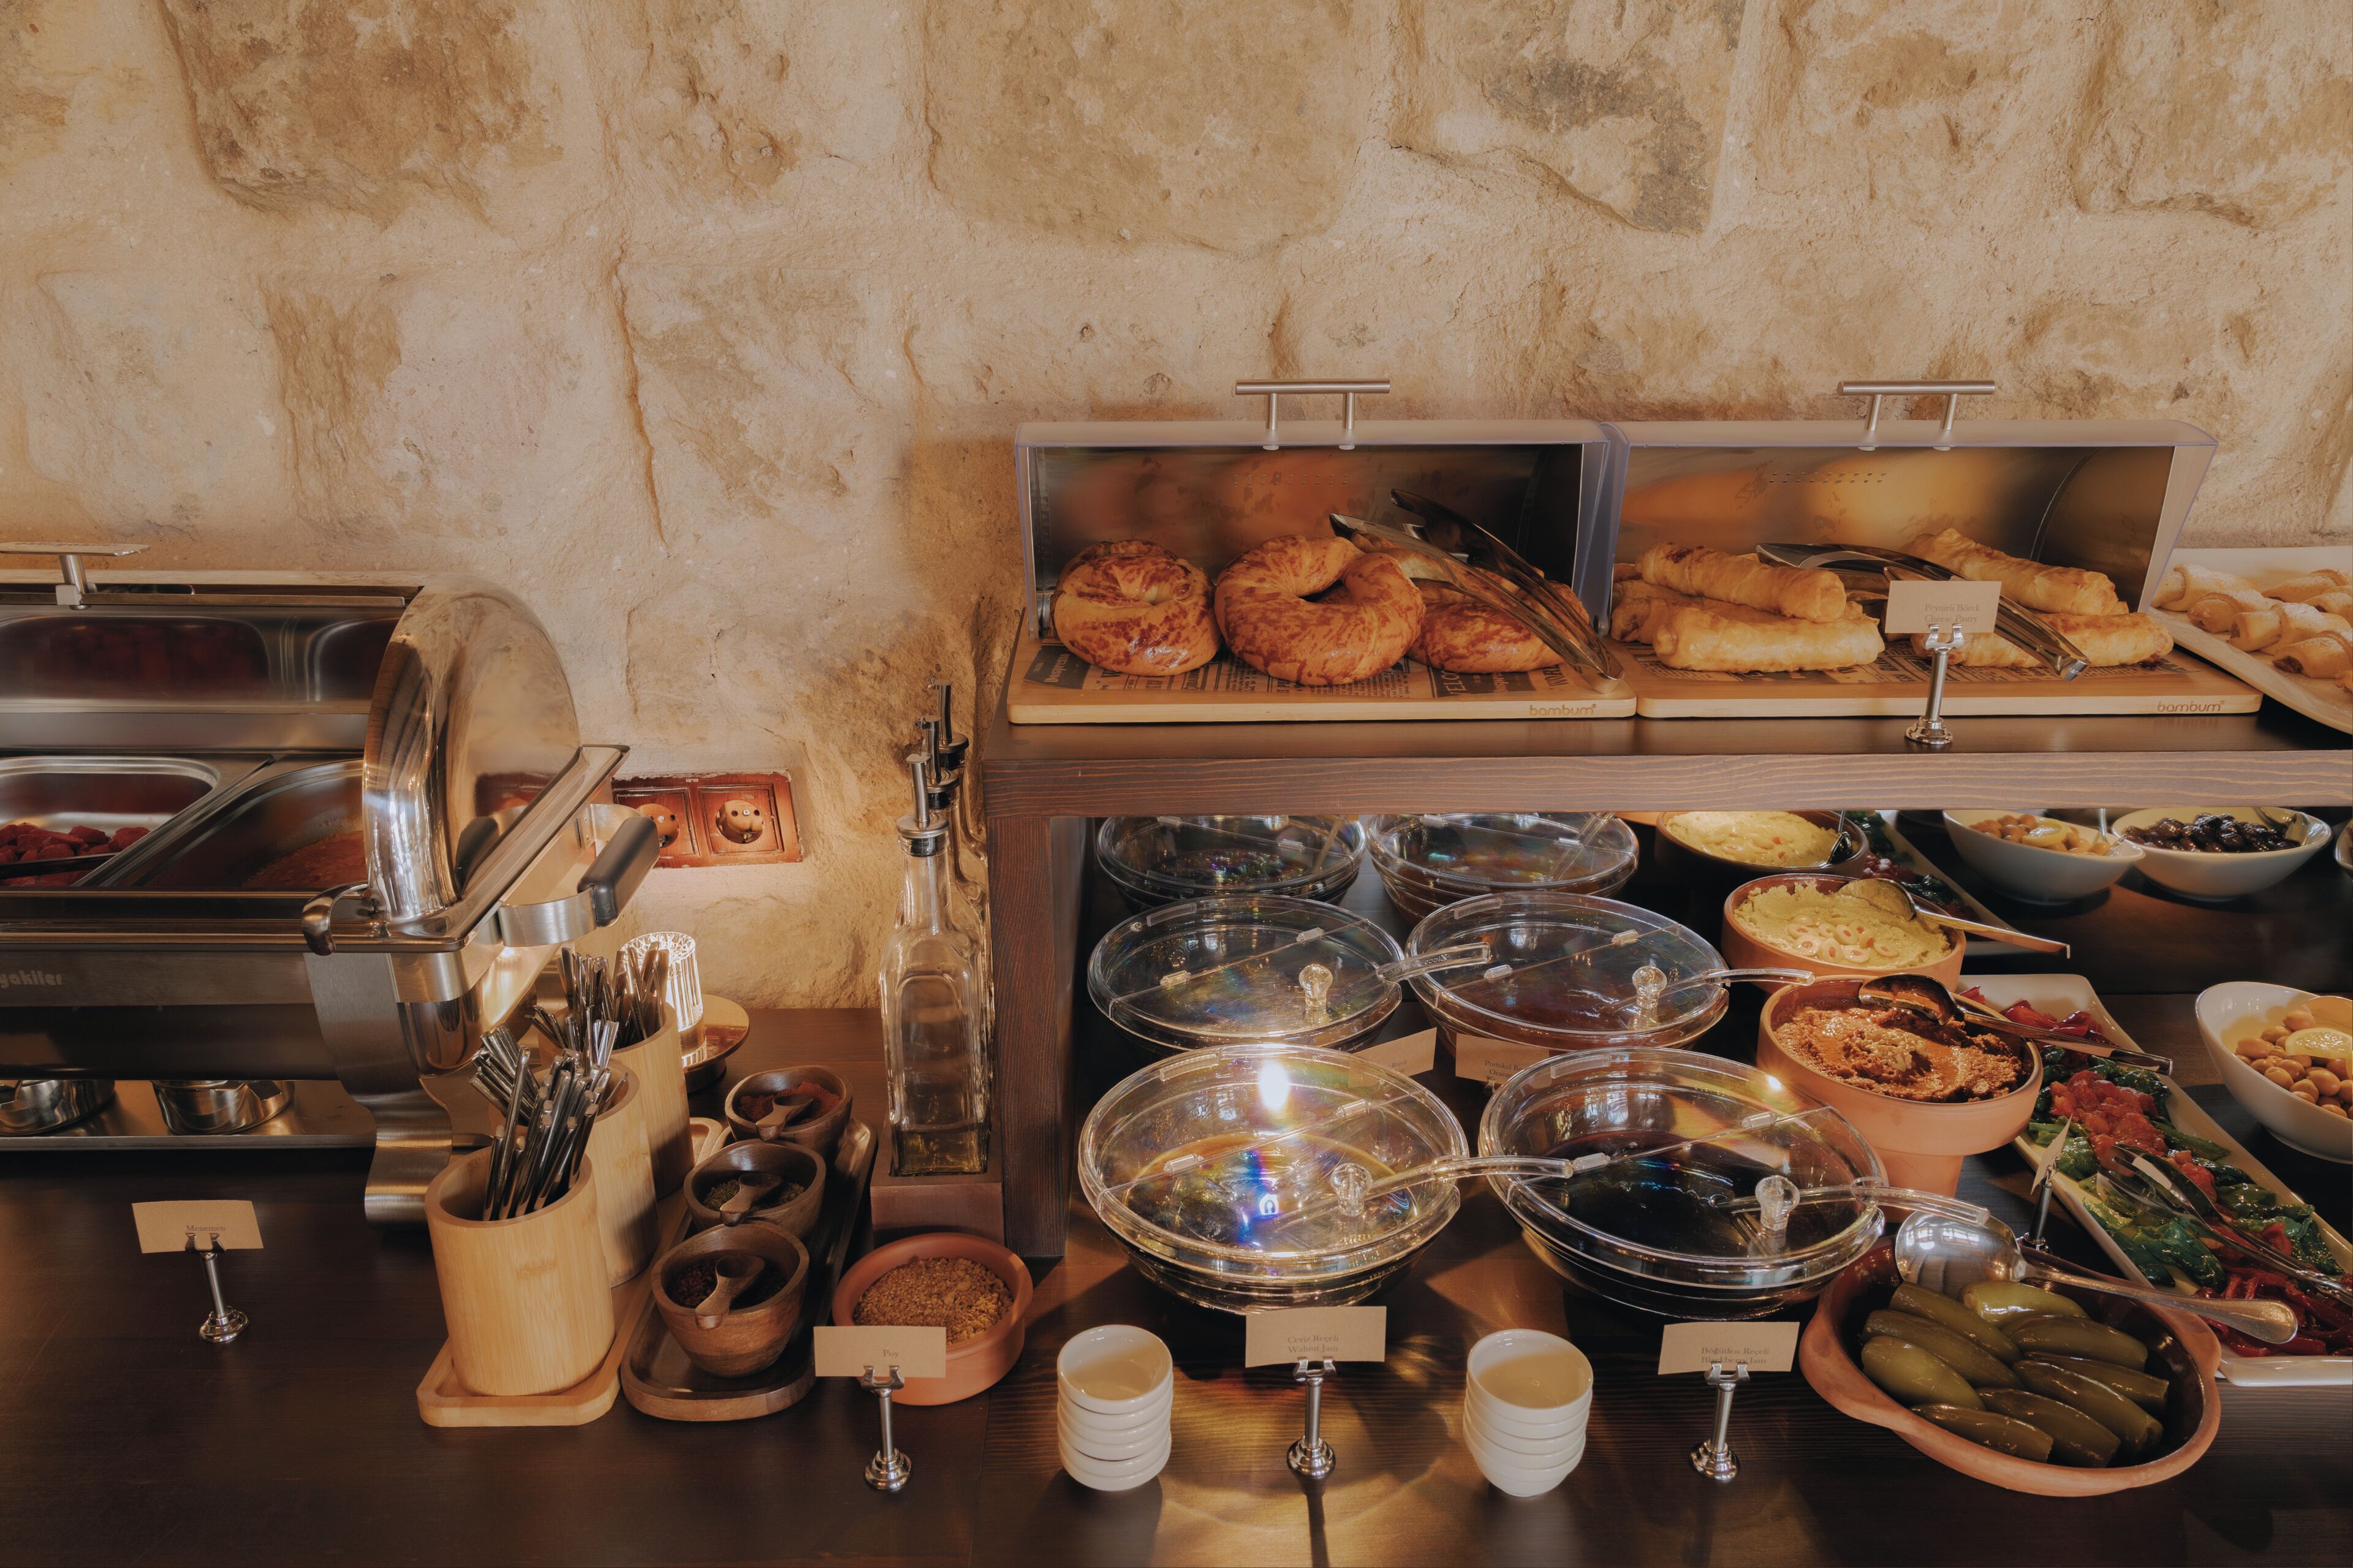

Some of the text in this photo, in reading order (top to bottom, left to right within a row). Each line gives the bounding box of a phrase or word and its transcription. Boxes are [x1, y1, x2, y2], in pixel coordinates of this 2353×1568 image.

[1925, 603, 1980, 613] Peynirli Börek
[1924, 614, 1978, 624] Cheese Pastry
[1529, 703, 1594, 716] bambum
[2157, 700, 2222, 712] bambum
[1485, 1059, 1512, 1070] Portakal
[1287, 1334, 1339, 1344] Ceviz Reçeli
[883, 1349, 900, 1358] Poy
[1287, 1344, 1339, 1354] Walnut Jam
[1743, 1347, 1770, 1355] Reçeli
[1701, 1355, 1767, 1364] Blackberry Jam
